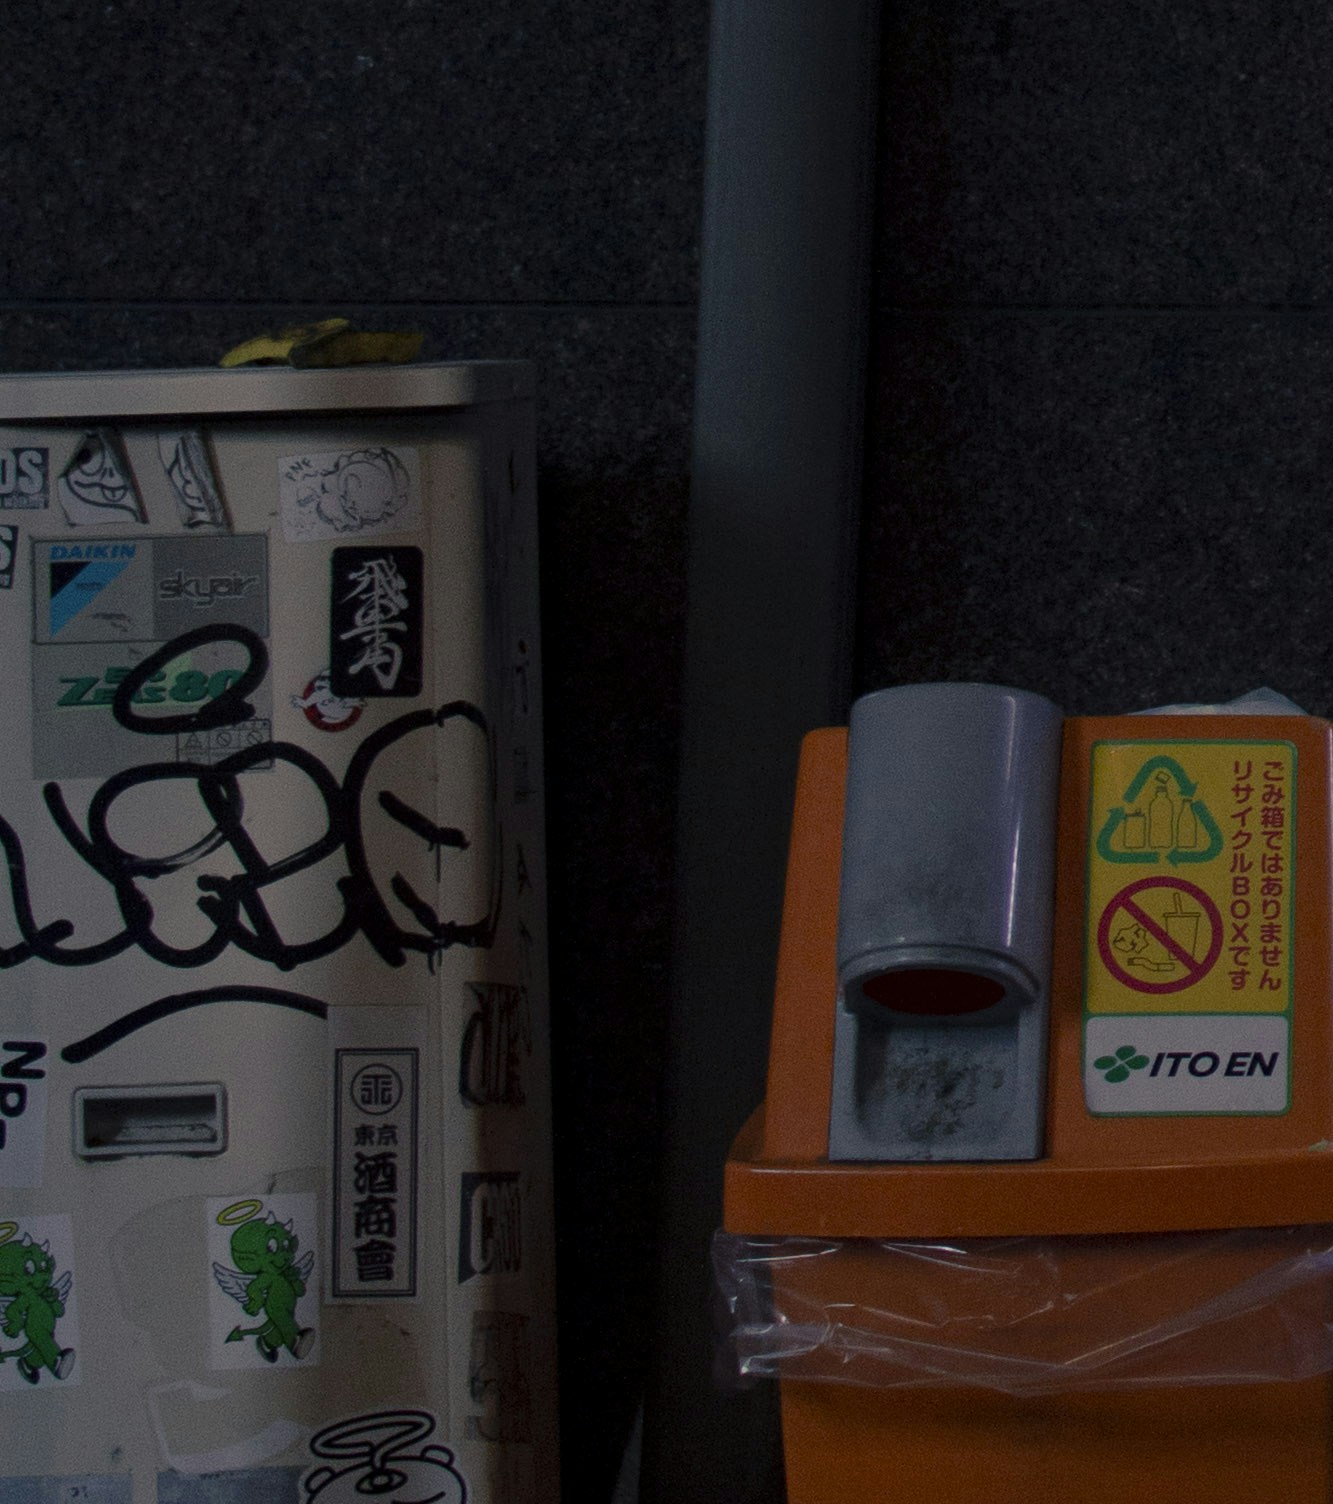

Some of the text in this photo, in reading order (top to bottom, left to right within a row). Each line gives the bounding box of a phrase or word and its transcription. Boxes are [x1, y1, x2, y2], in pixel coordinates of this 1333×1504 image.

[51, 544, 137, 560] DAIKIN
[1228, 758, 1255, 991] リサイクルBOXです
[1258, 758, 1283, 993] ごみ箱ではありません
[1150, 1051, 1280, 1079] ITO EN
[354, 1125, 399, 1146] 東京
